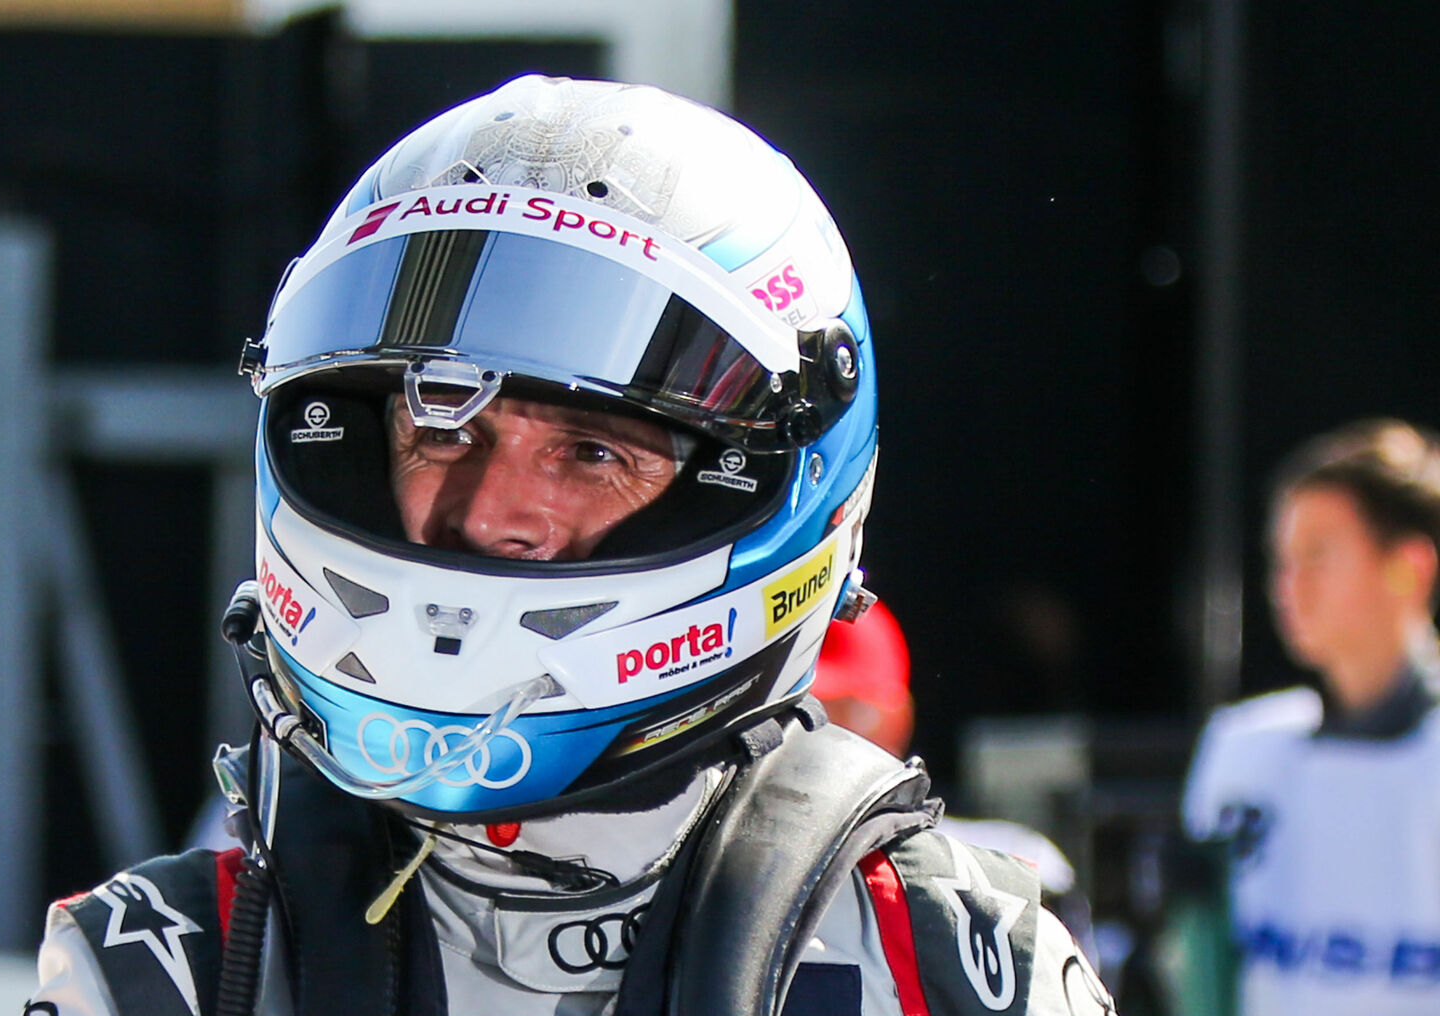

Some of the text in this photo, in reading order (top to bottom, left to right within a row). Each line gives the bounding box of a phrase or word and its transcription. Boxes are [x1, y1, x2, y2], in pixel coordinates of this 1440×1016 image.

[400, 193, 661, 261] Audi Sport
[292, 430, 342, 441] SCHUBERTH
[700, 472, 755, 490] SCHUBERTH
[771, 554, 833, 624] Brunel
[616, 607, 738, 684] porta!
